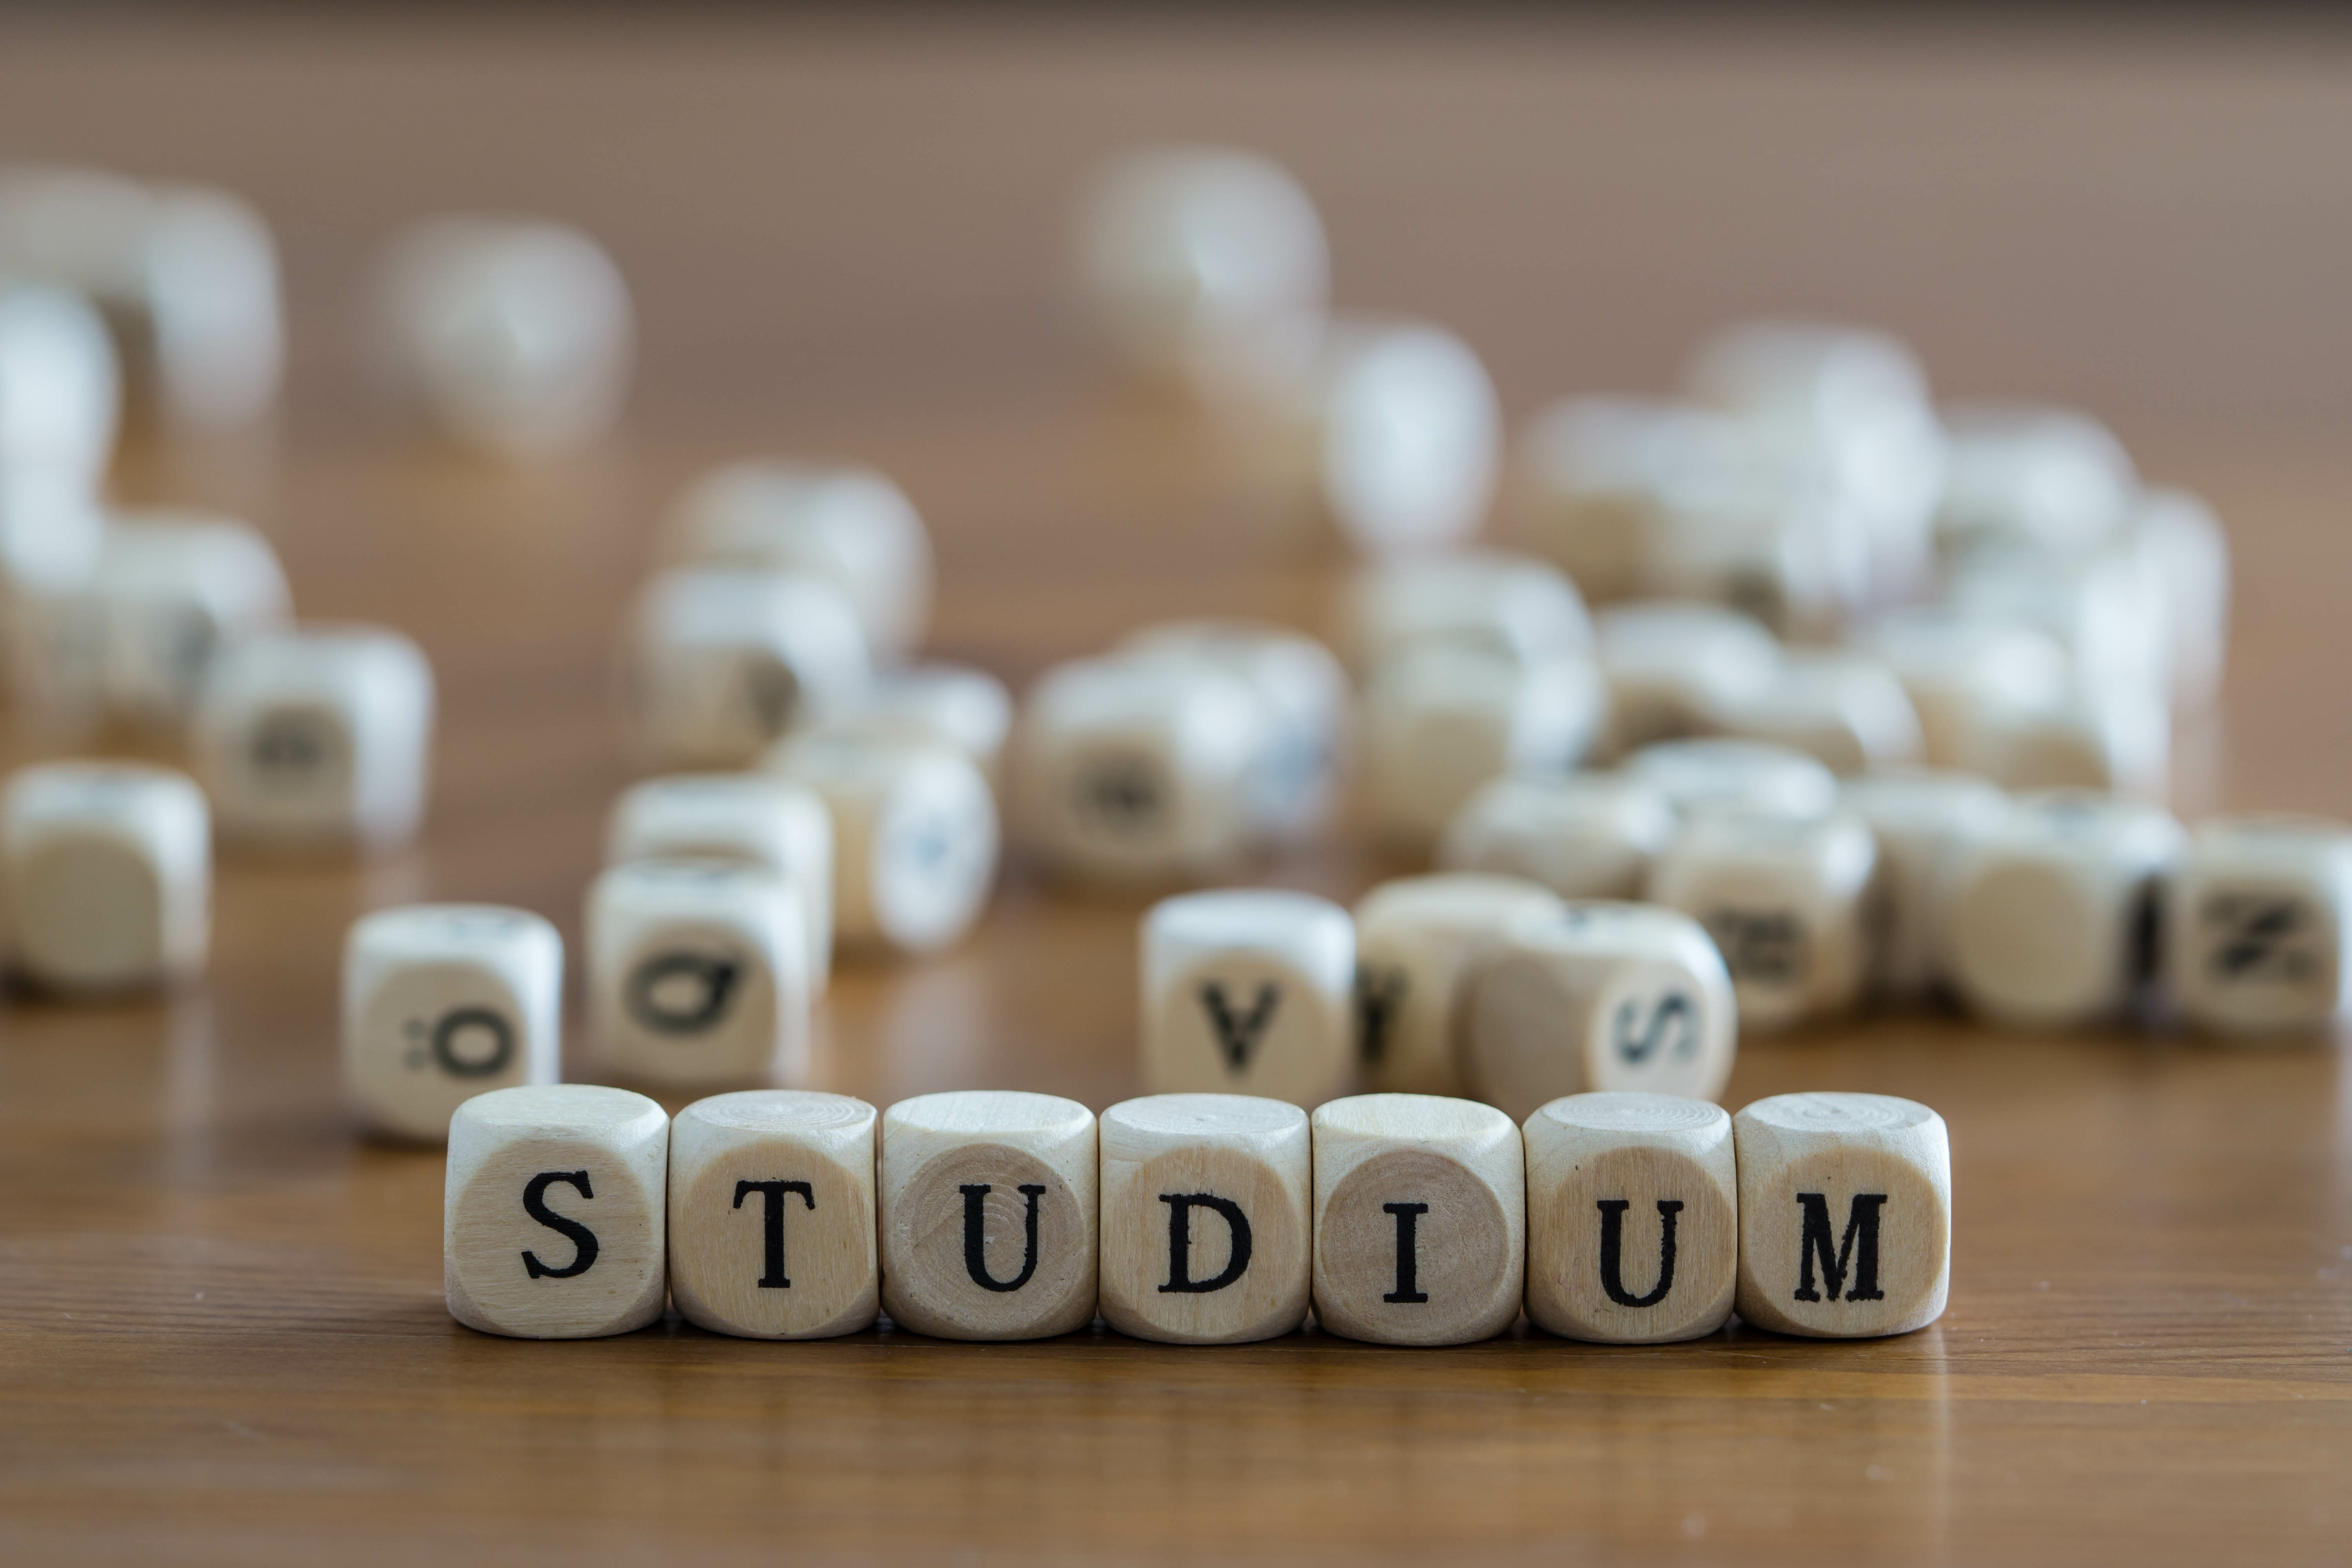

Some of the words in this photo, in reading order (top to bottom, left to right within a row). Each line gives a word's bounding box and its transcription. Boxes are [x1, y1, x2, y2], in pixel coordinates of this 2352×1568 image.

[622, 949, 750, 1036] Q
[1198, 979, 1280, 1075] V
[1610, 991, 1701, 1067] S
[401, 1004, 517, 1080] Ö
[521, 1171, 1887, 1308] STUDIUM
